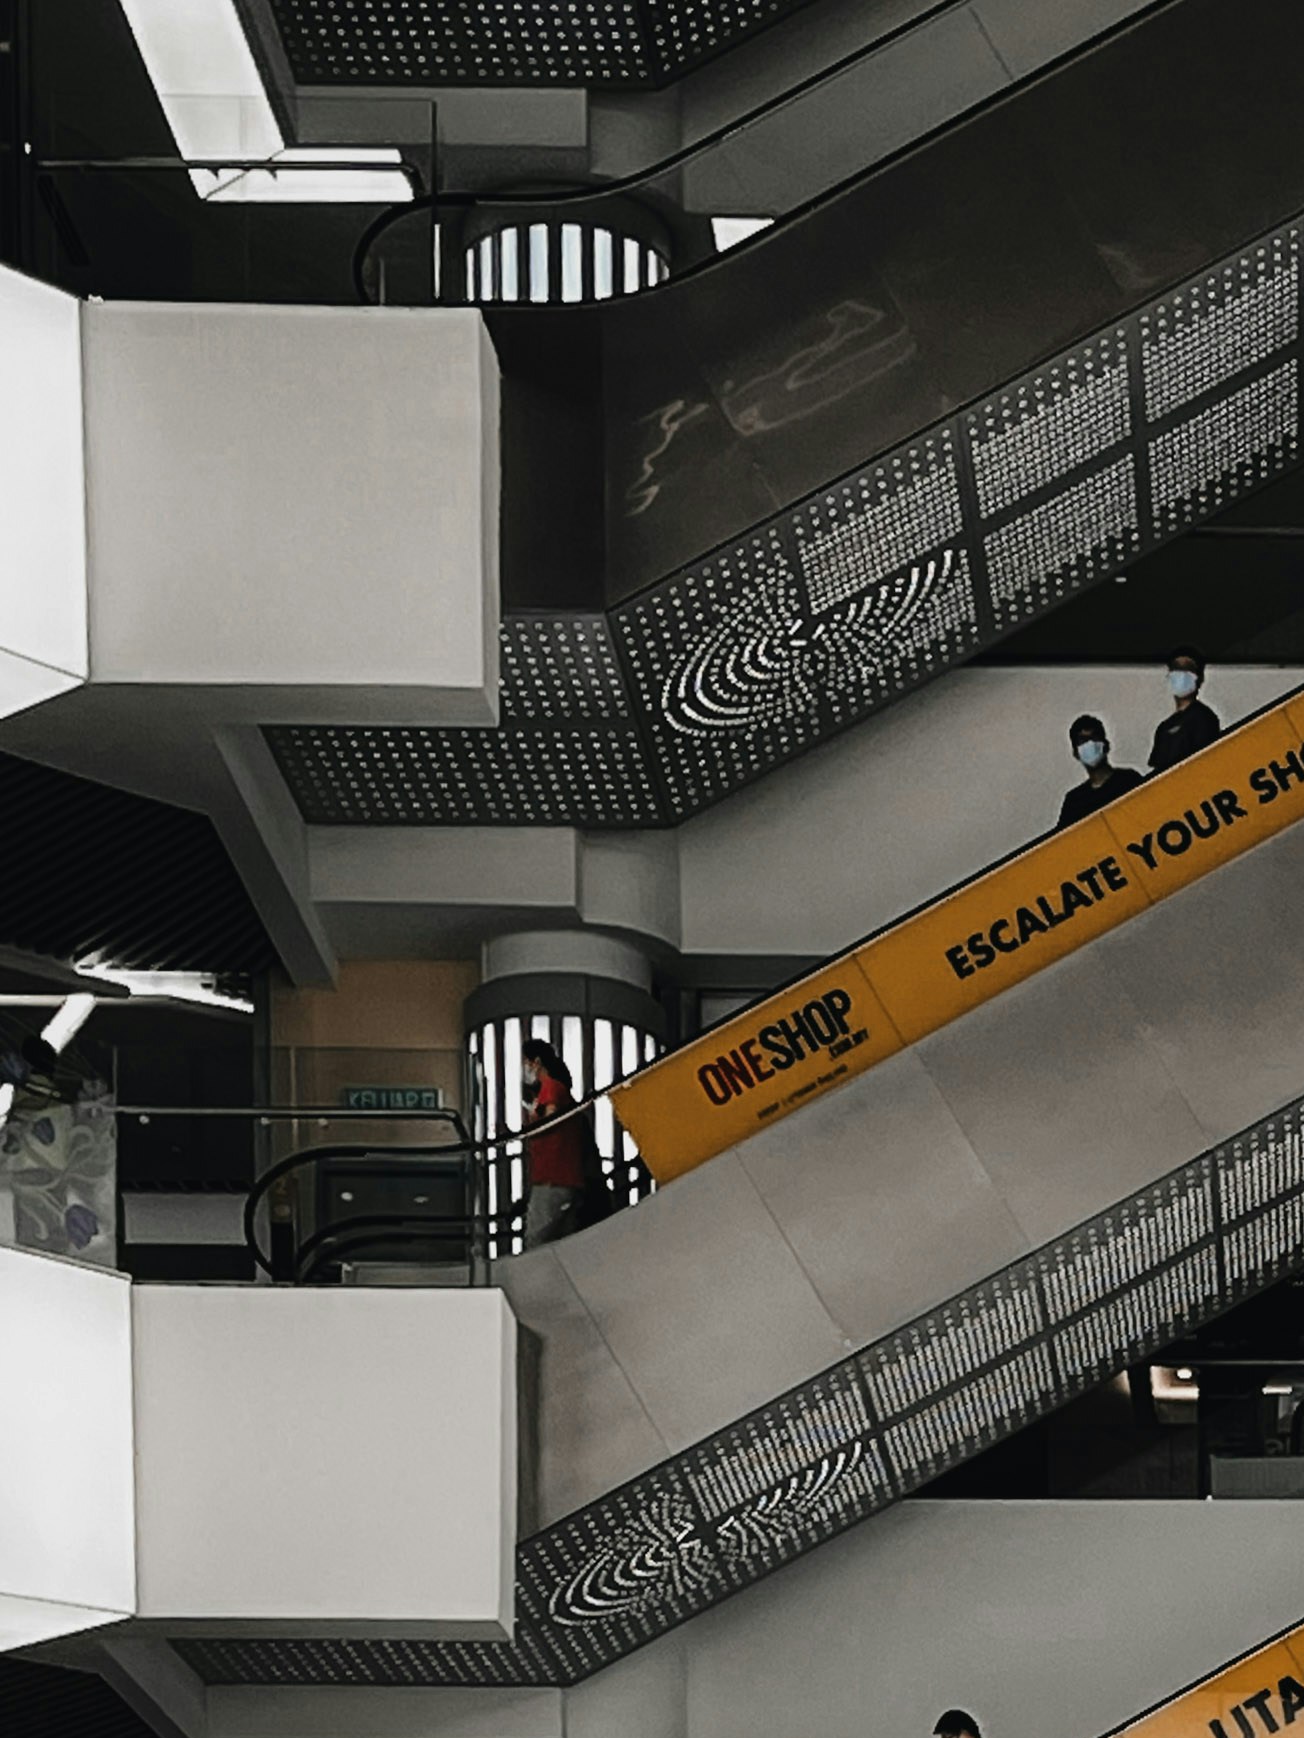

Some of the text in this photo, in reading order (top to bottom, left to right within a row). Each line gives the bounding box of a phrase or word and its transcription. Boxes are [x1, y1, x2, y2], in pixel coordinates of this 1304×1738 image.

[945, 856, 1128, 979] ESCALATE
[1127, 790, 1248, 870] YOUR
[698, 989, 851, 1106] ONESHOP
